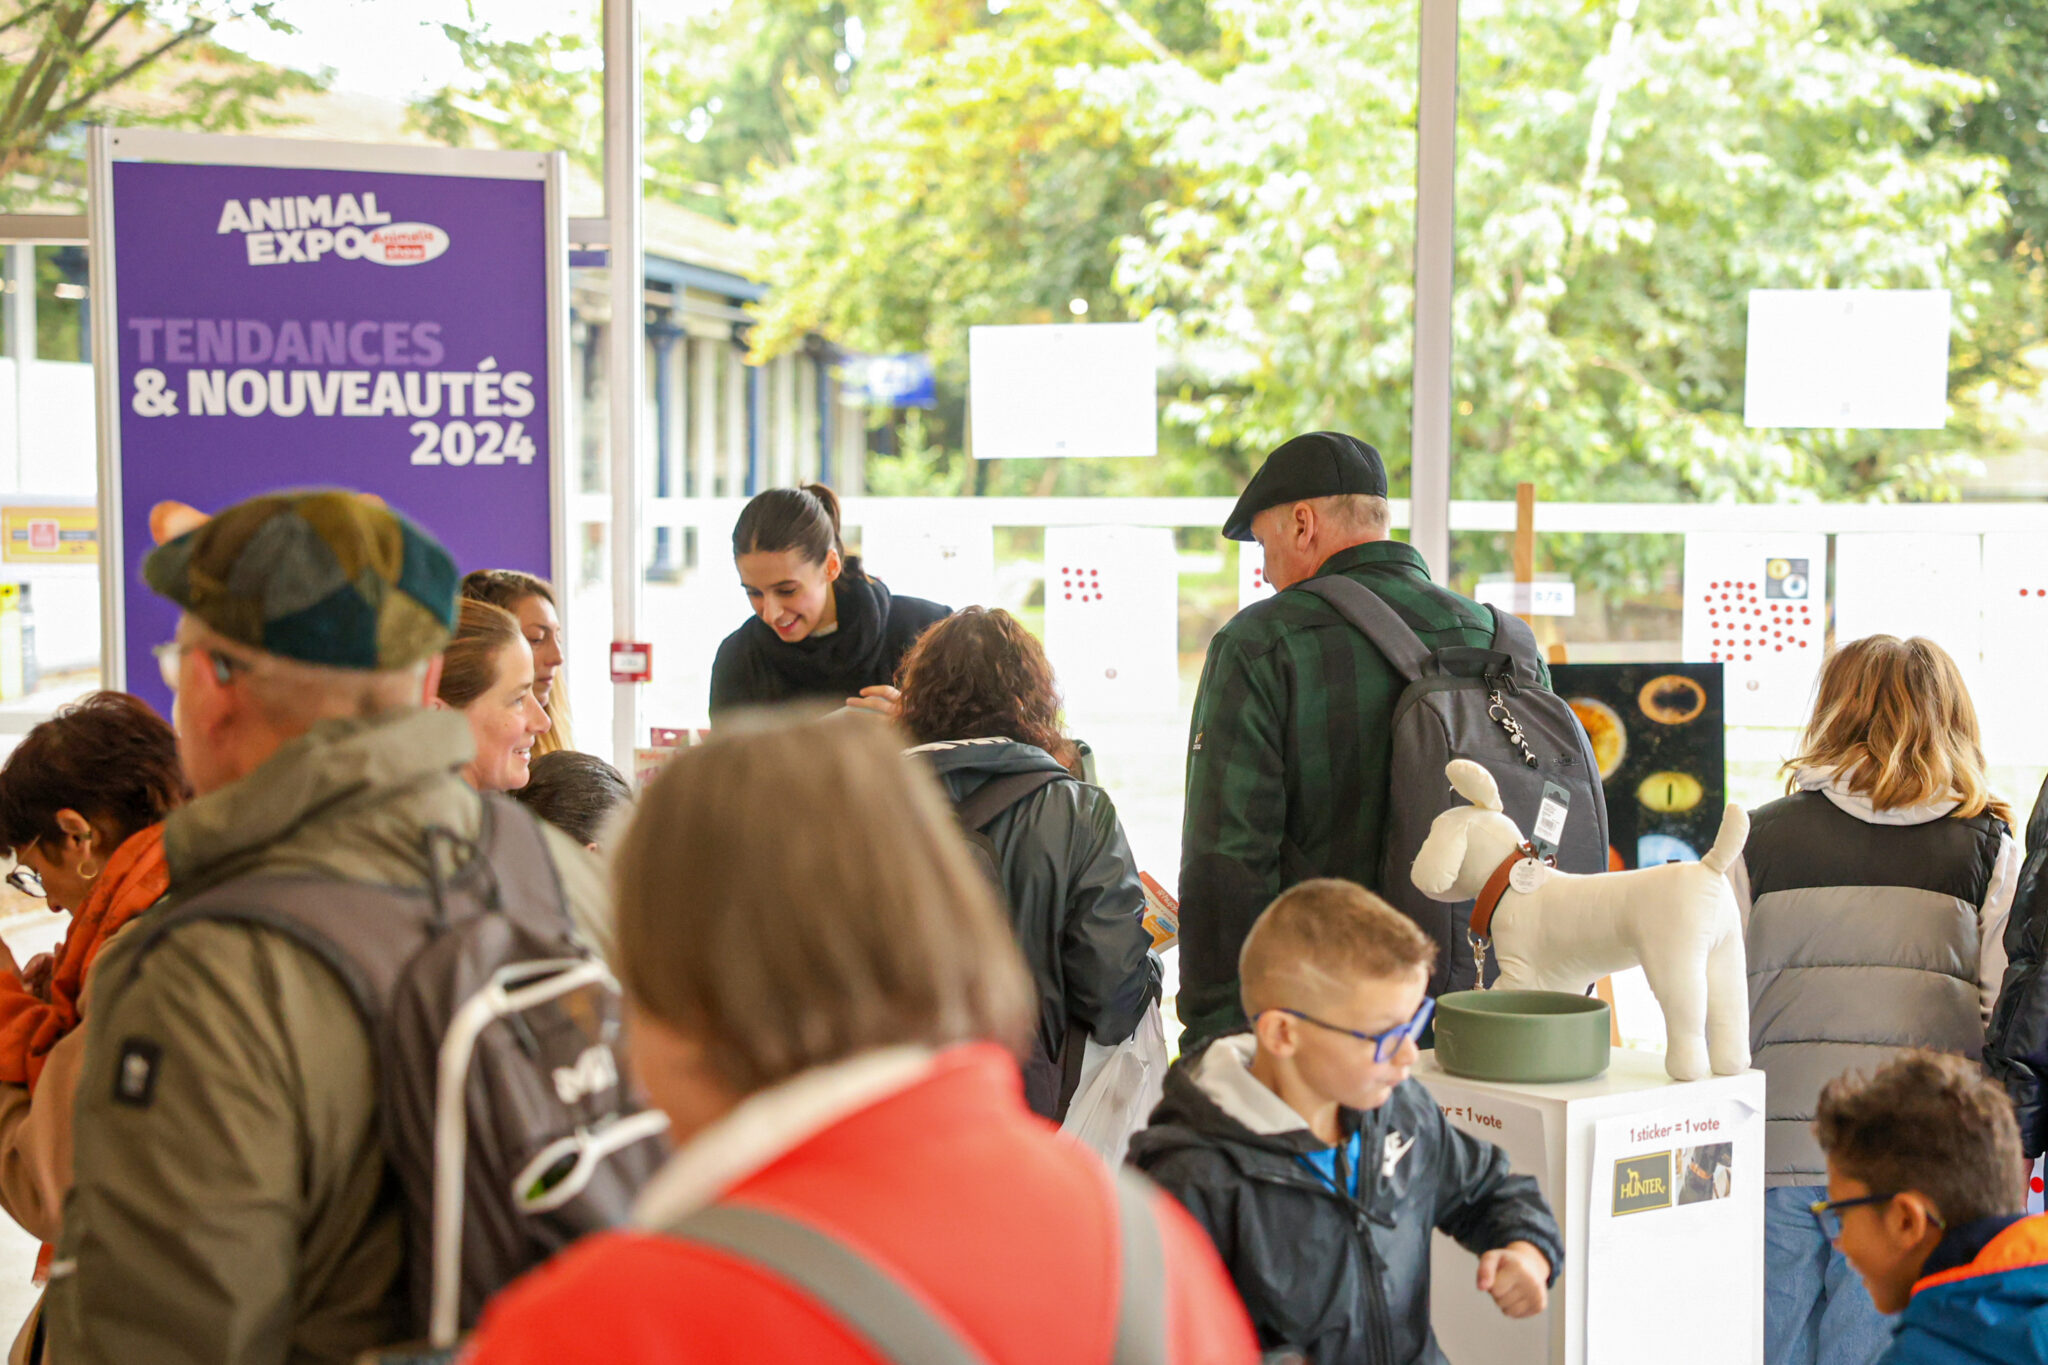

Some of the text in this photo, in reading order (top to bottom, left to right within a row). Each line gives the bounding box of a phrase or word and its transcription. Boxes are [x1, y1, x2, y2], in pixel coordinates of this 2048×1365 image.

[217, 192, 392, 234] ANIMAL
[246, 226, 368, 266] EXPO
[128, 317, 445, 367] TENDANCES
[132, 356, 536, 418] & NOUVEAUTÉS
[409, 420, 537, 467] 2024
[1475, 1112, 1502, 1129] vote
[1637, 1122, 1672, 1142] sticker
[1693, 1117, 1720, 1133] vote
[1620, 1177, 1663, 1199] HUNTER
